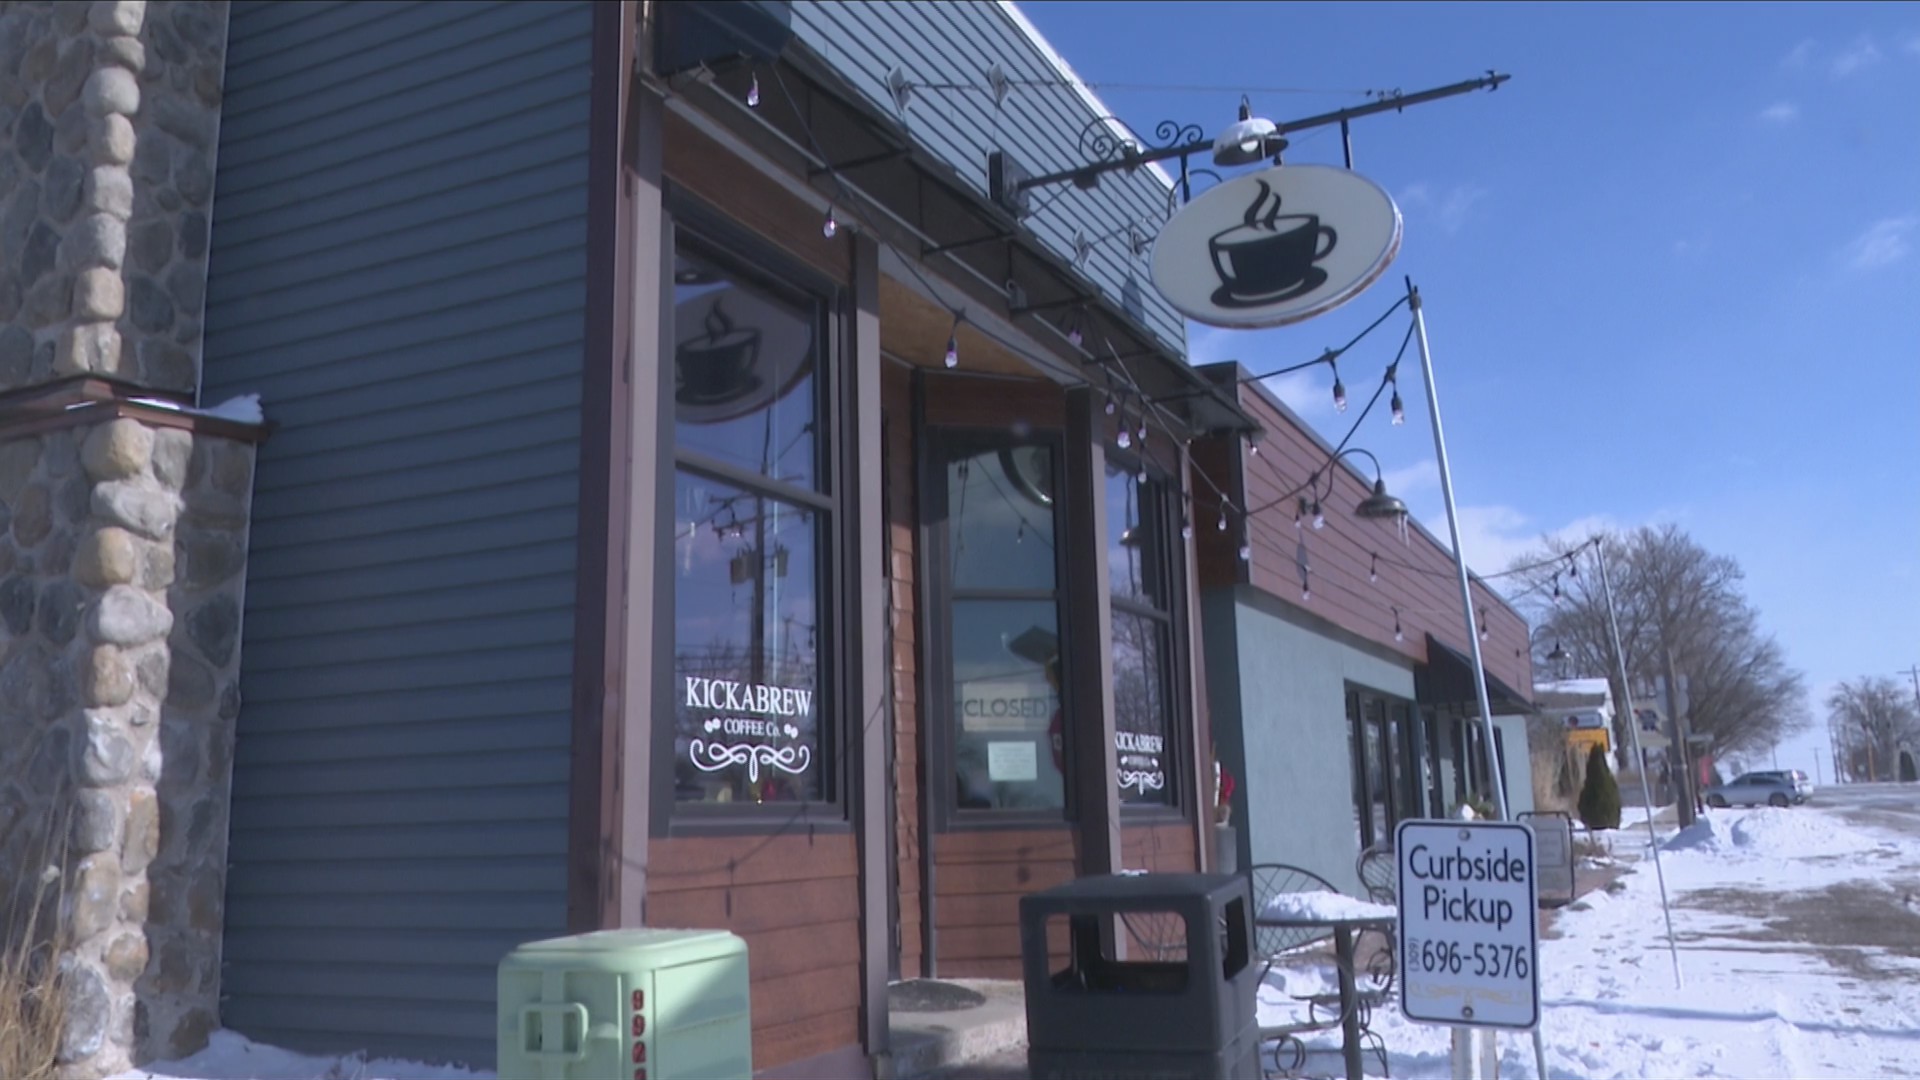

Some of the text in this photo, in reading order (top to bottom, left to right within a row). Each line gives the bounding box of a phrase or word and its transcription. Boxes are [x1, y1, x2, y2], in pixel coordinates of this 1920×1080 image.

[686, 676, 812, 717] KICKABREW
[964, 698, 1047, 718] CLOSED
[724, 717, 765, 736] COFFEE
[1409, 844, 1525, 883] Curbside
[1423, 885, 1513, 931] Pickup
[1422, 939, 1528, 979] 696-5376
